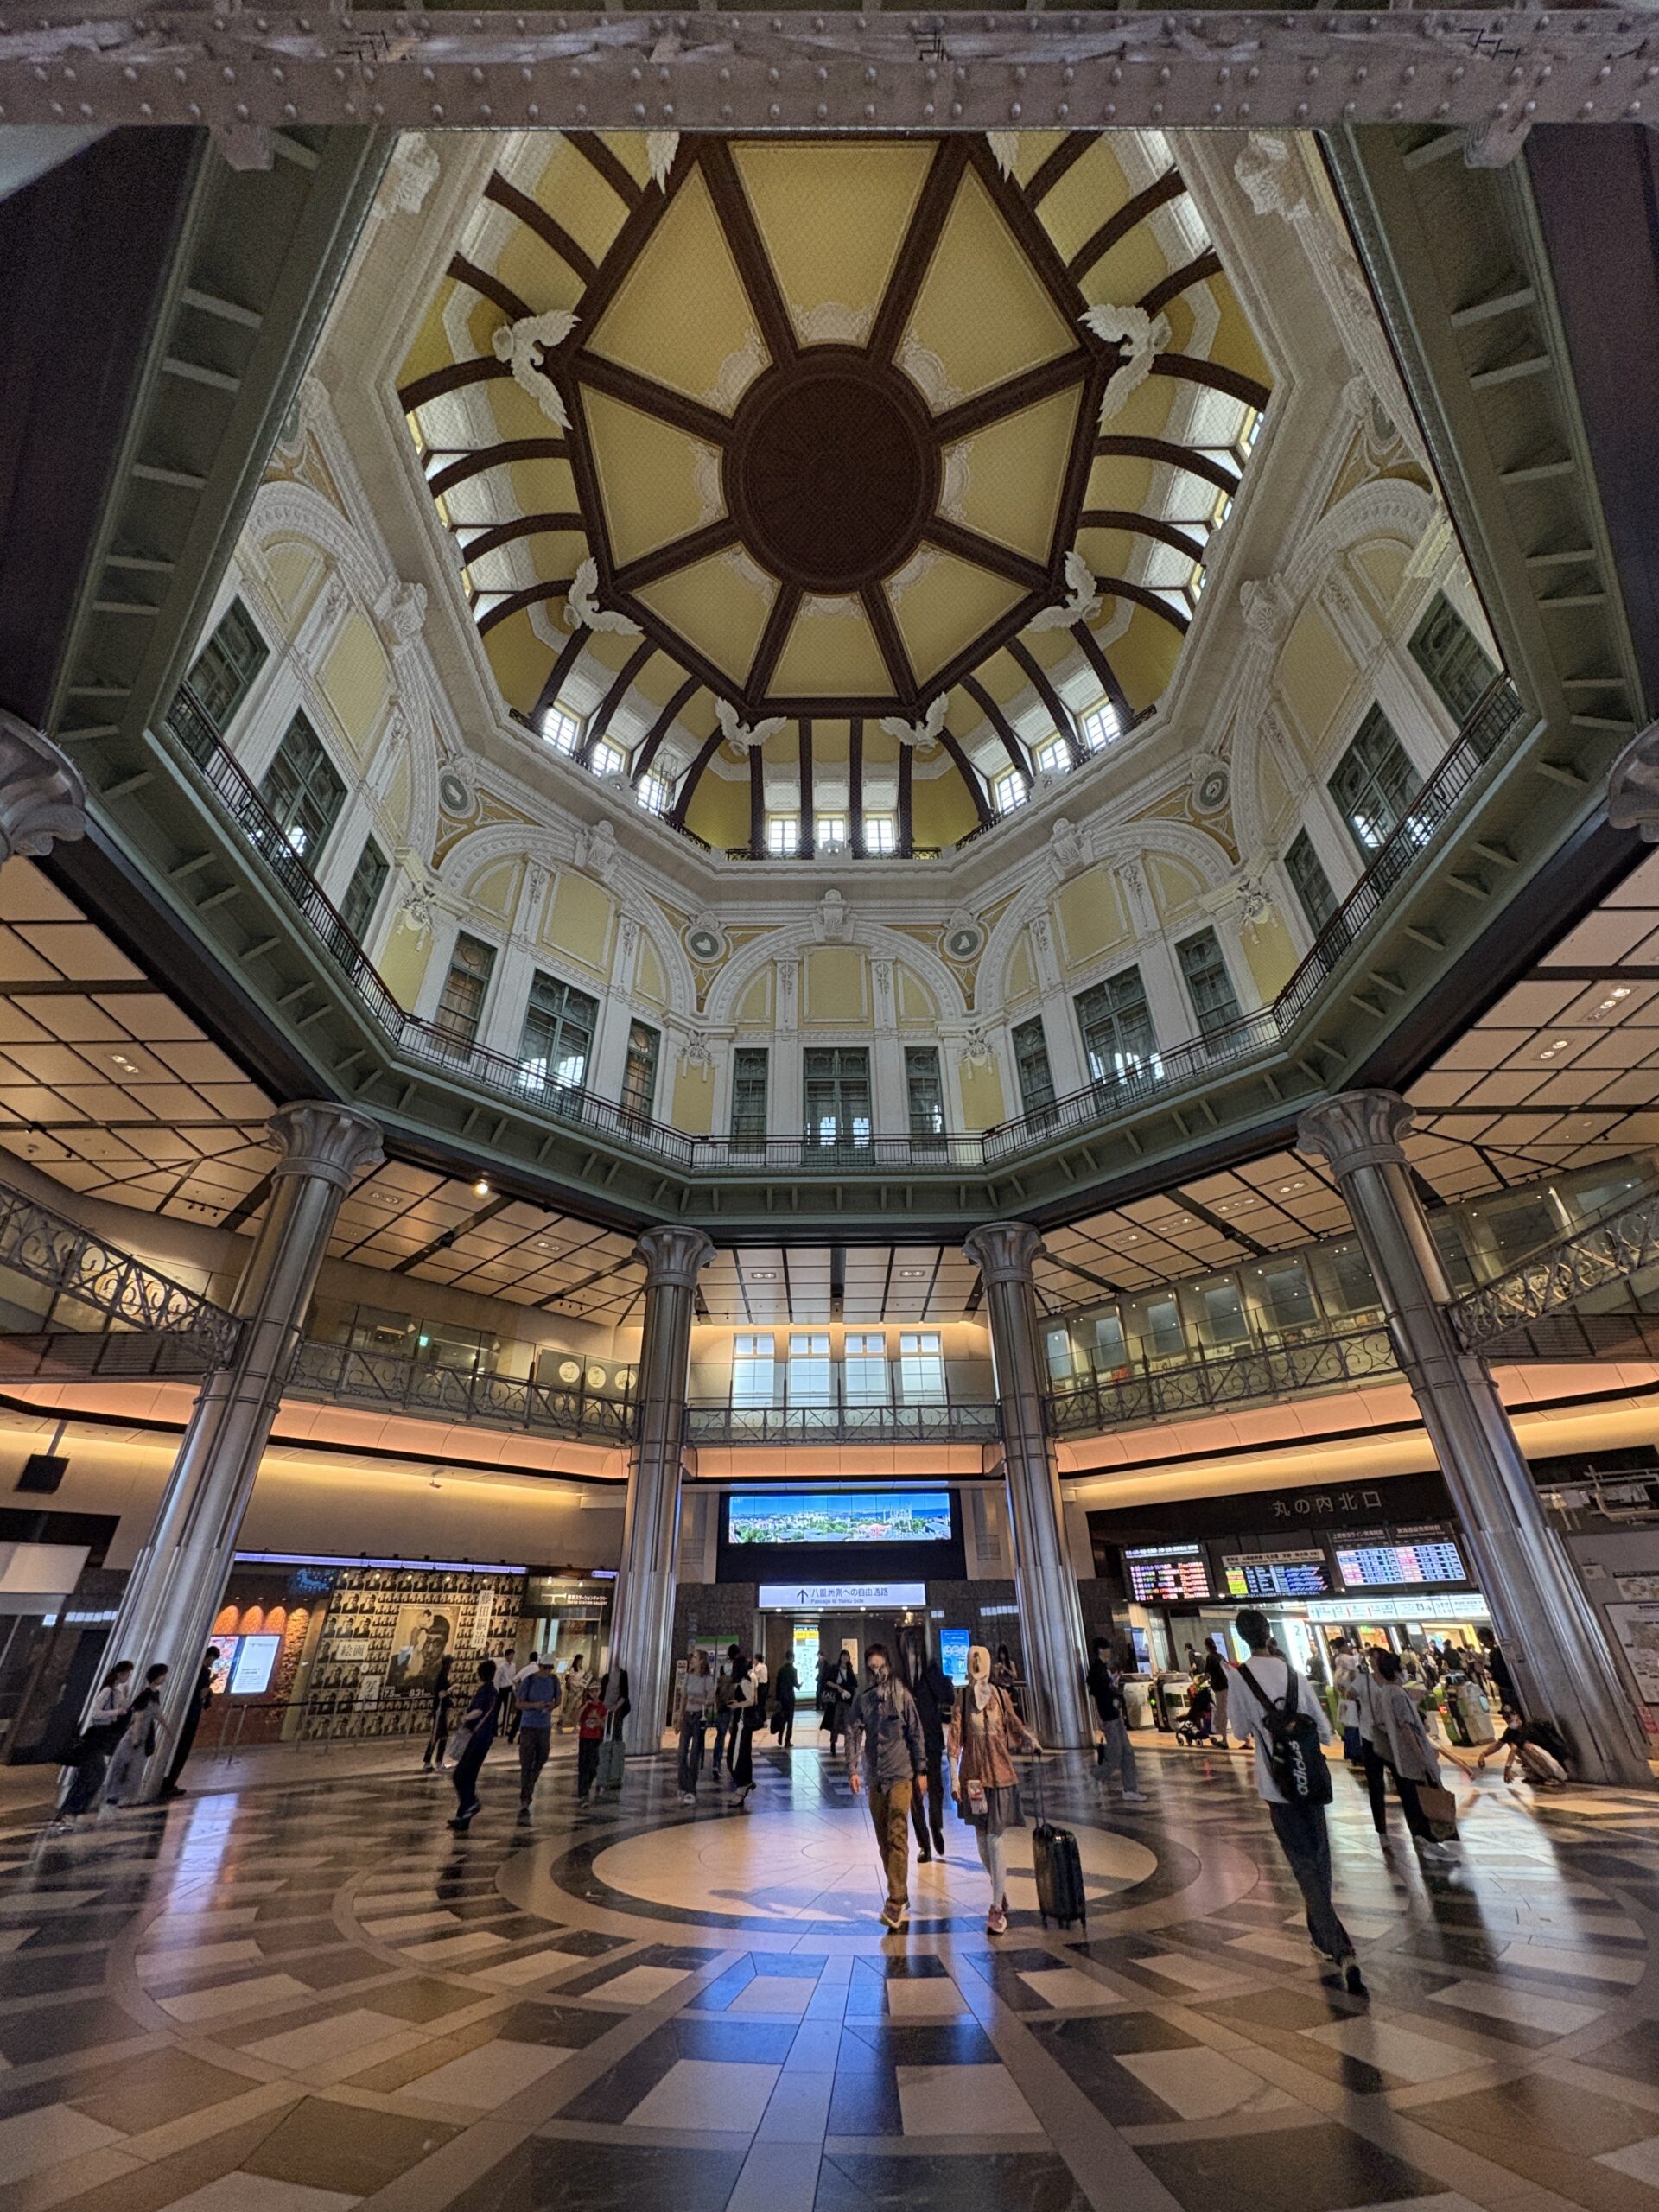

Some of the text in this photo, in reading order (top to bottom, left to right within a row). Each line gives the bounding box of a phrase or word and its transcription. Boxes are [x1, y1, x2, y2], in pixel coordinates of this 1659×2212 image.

[1272, 1491, 1382, 1517] 丸の内北口
[811, 1587, 888, 1598] 八重洲側への自由通路
[1294, 1625, 1300, 1636] 2
[340, 1643, 365, 1657] 絵画
